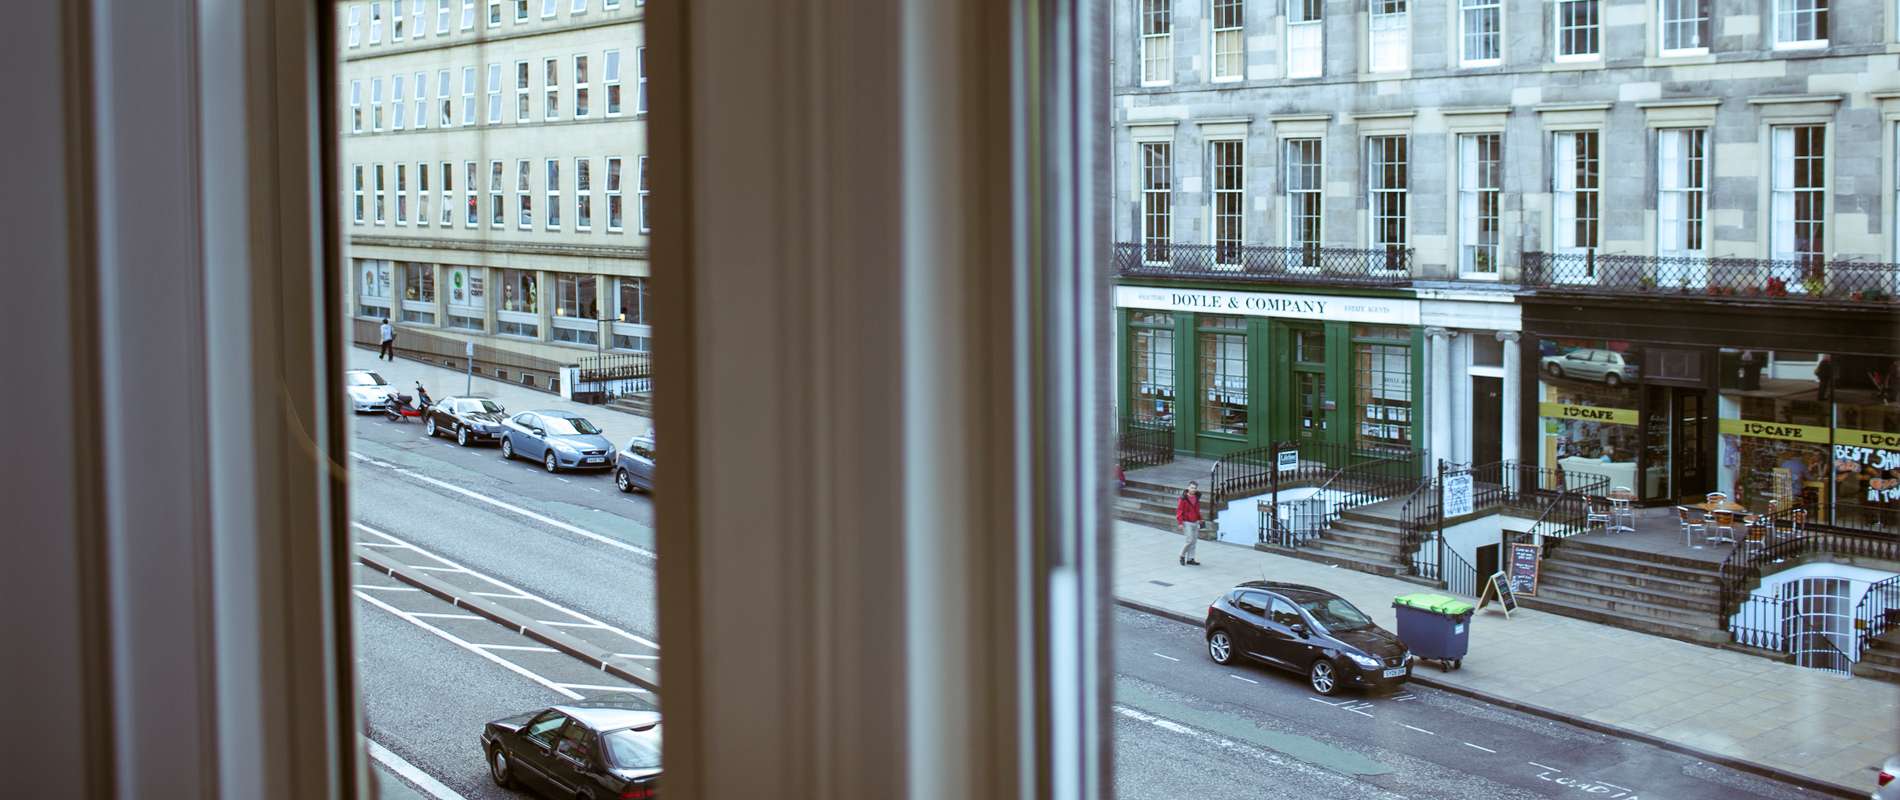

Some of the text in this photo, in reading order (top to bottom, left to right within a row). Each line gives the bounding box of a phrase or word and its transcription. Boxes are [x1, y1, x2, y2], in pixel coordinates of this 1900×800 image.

[1172, 293, 1327, 314] DOYLE & COMPANY
[1581, 409, 1614, 420] CAFE
[1765, 425, 1803, 438] CAFE
[1834, 444, 1874, 465] BEST
